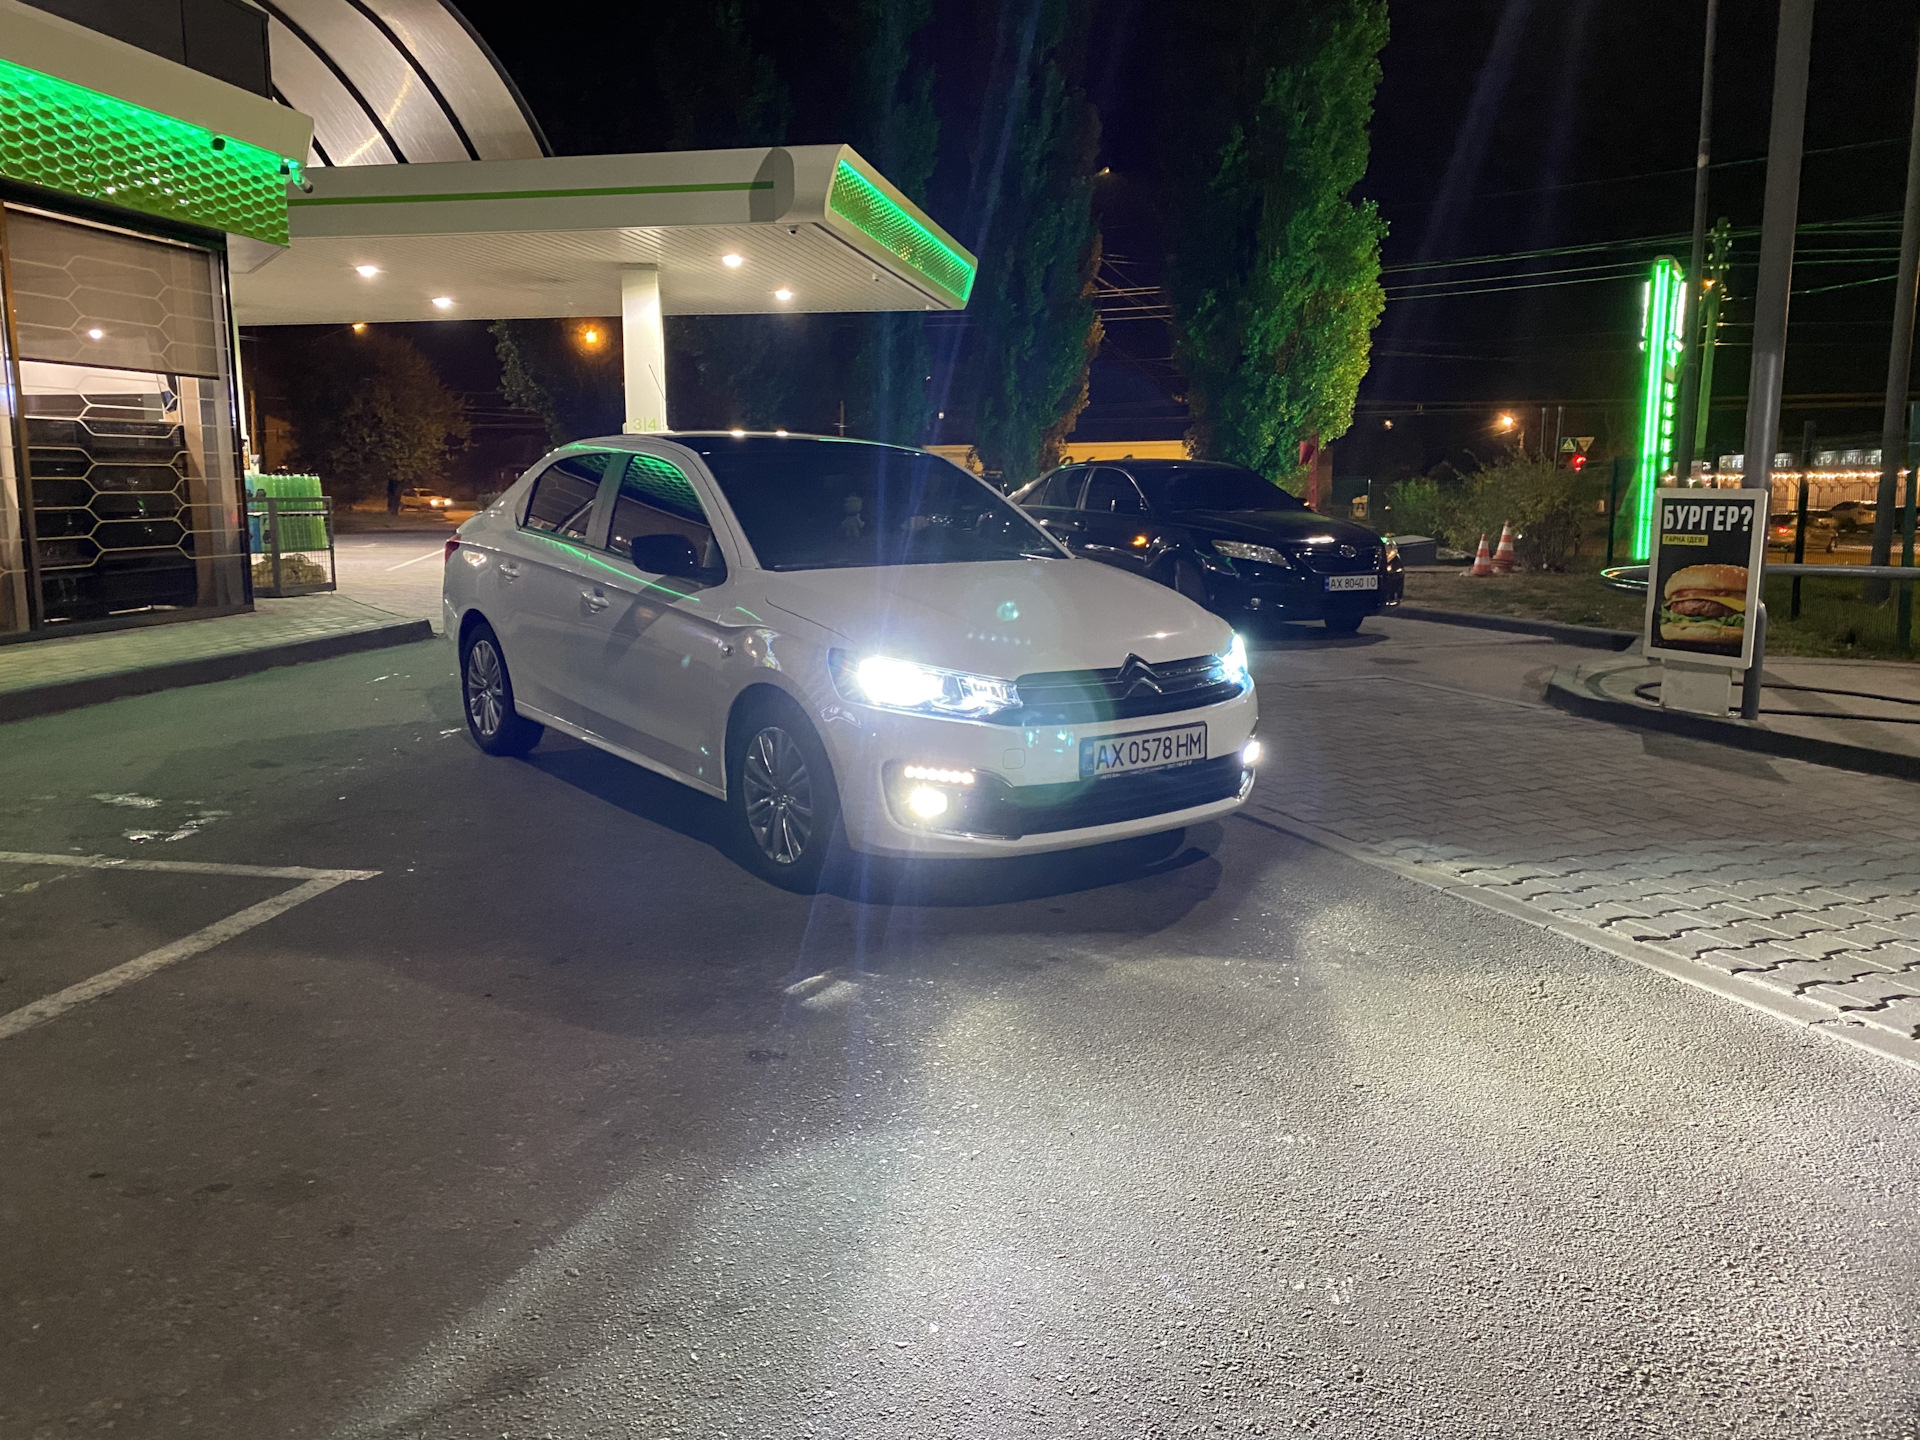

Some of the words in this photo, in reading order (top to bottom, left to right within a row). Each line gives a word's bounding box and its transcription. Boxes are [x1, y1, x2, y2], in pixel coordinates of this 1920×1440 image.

[1663, 505, 1753, 532] БУРГЕР?
[1664, 535, 1686, 543] ГАРНА
[1330, 578, 1343, 589] AX
[1344, 578, 1364, 589] 8040
[1095, 741, 1125, 770] AX
[1129, 736, 1172, 765] 0578
[1176, 732, 1202, 758] HM
